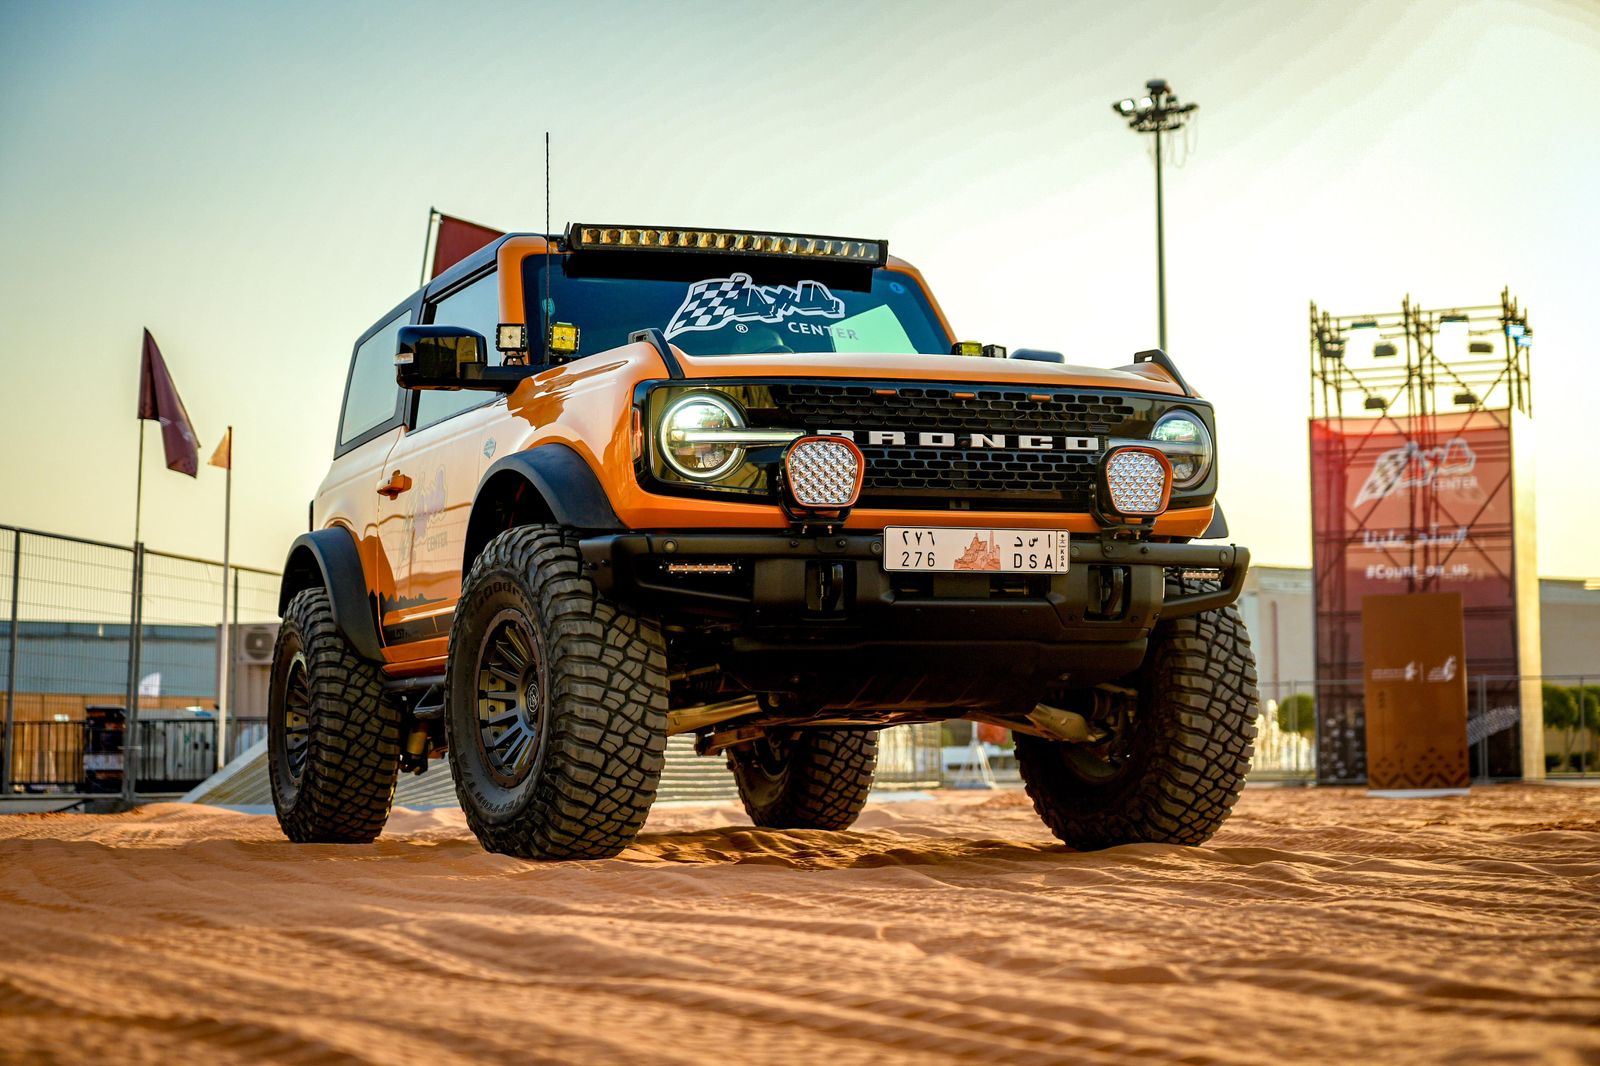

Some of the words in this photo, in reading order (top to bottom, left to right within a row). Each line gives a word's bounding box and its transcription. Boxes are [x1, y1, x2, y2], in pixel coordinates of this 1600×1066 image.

[788, 321, 859, 341] CENTER
[901, 551, 936, 568] 276
[1013, 553, 1053, 569] DSA
